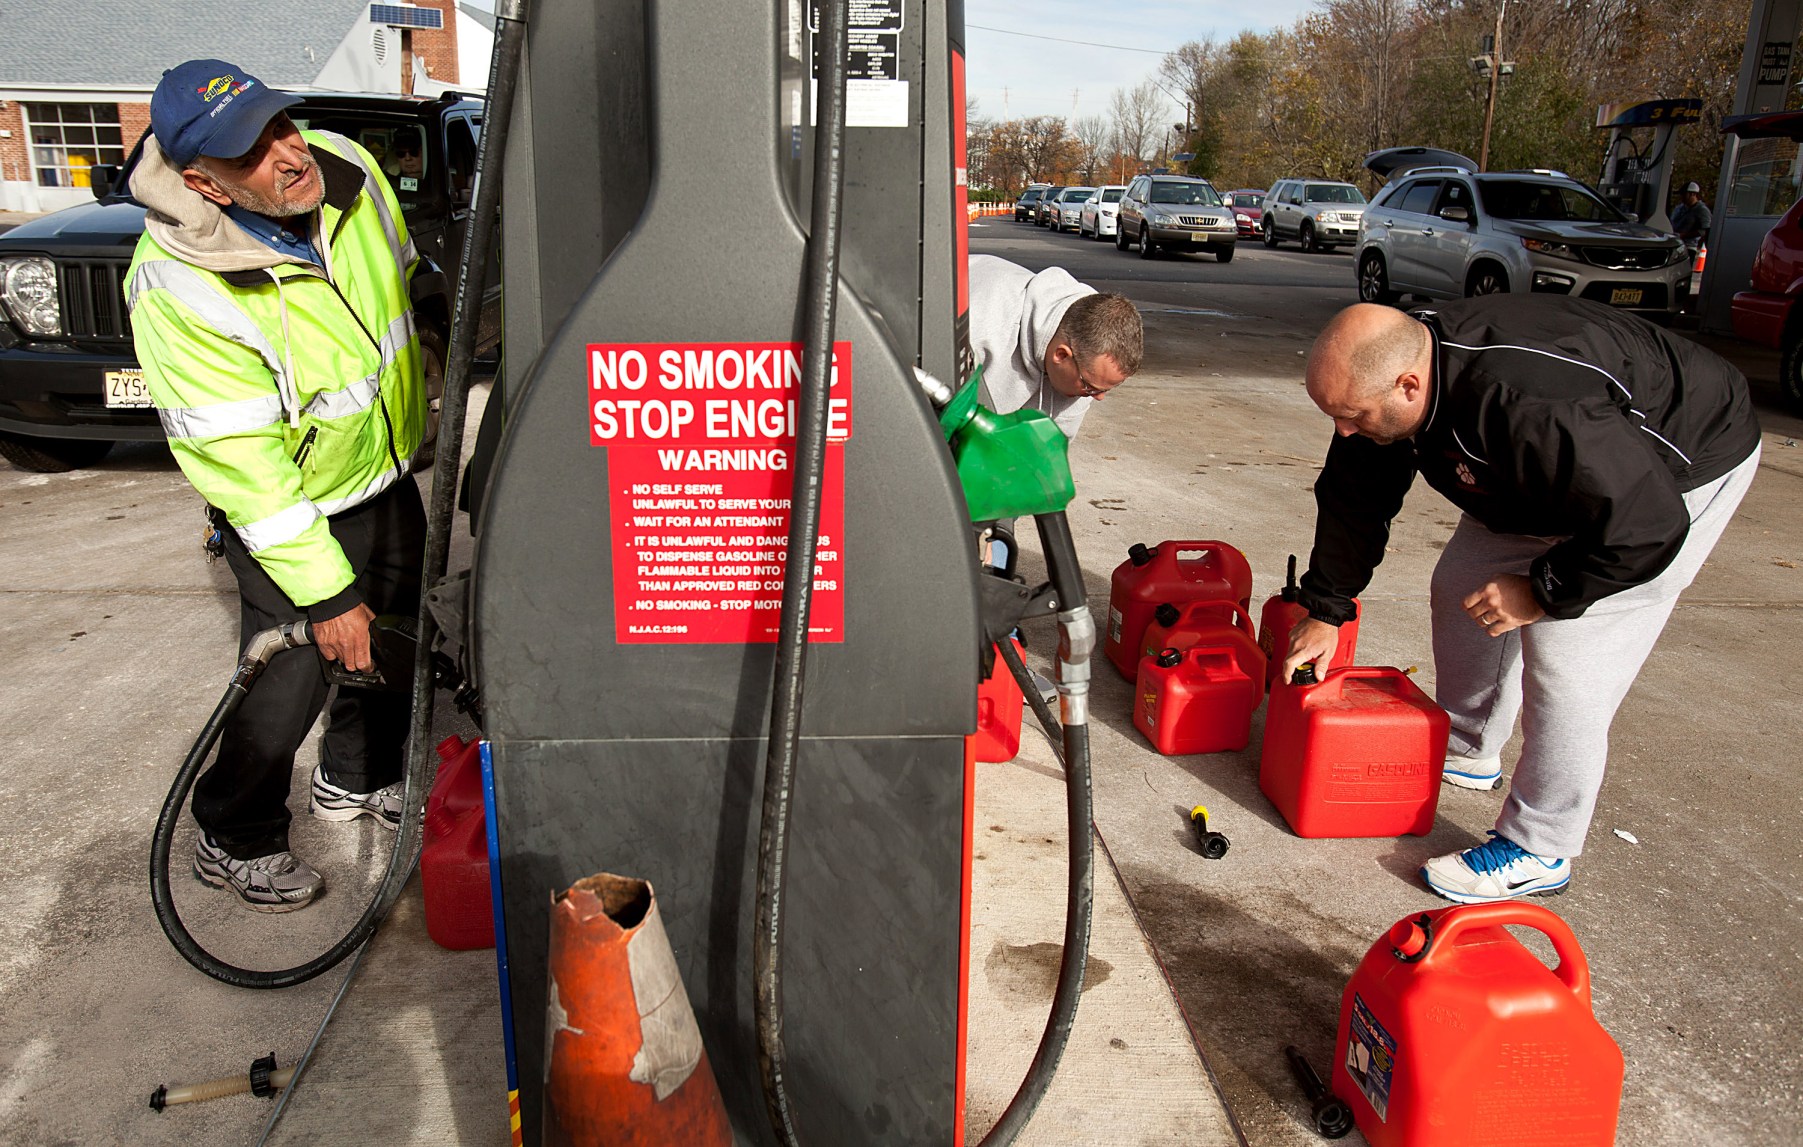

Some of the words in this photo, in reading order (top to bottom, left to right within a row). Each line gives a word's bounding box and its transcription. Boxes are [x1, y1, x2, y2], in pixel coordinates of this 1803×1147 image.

[204, 75, 233, 101] SUNOCO
[1650, 108, 1663, 118] 3
[454, 265, 467, 323] FUTURA
[823, 259, 832, 319] FUTURA
[592, 350, 647, 390] NO
[594, 400, 694, 439] STOP
[706, 399, 848, 438] ENGIE
[658, 449, 786, 470] WARNING
[633, 484, 651, 494] NO
[652, 484, 682, 495] SELF
[684, 484, 723, 495] SERVE
[633, 499, 698, 509] UNLAWFUL
[700, 499, 715, 509] TO
[718, 499, 757, 509] SERVE
[758, 499, 791, 509] YOUR
[633, 516, 664, 526] WAIT
[666, 516, 691, 527] FOR
[694, 517, 711, 527] AN
[714, 516, 783, 527] ATTENDANT
[634, 536, 646, 546] IT
[648, 536, 660, 546] IS
[662, 536, 726, 546] UNLAWFUL
[728, 536, 754, 546] AND
[756, 536, 830, 546] DANGUS
[637, 551, 654, 562] TO
[656, 551, 714, 562] DISPENSE
[716, 551, 775, 561] GASOLINE
[638, 566, 710, 576] FLAMMABLE
[712, 566, 751, 576] LIQUID
[754, 566, 780, 575] INTO
[638, 581, 670, 591] THAN
[673, 581, 735, 591] APPROVED
[738, 581, 761, 590] RED
[636, 600, 654, 610] NO
[656, 600, 711, 610] SMOKING
[720, 600, 751, 610] STOP
[794, 585, 808, 643] FUTURA
[770, 890, 779, 943] FUTURA
